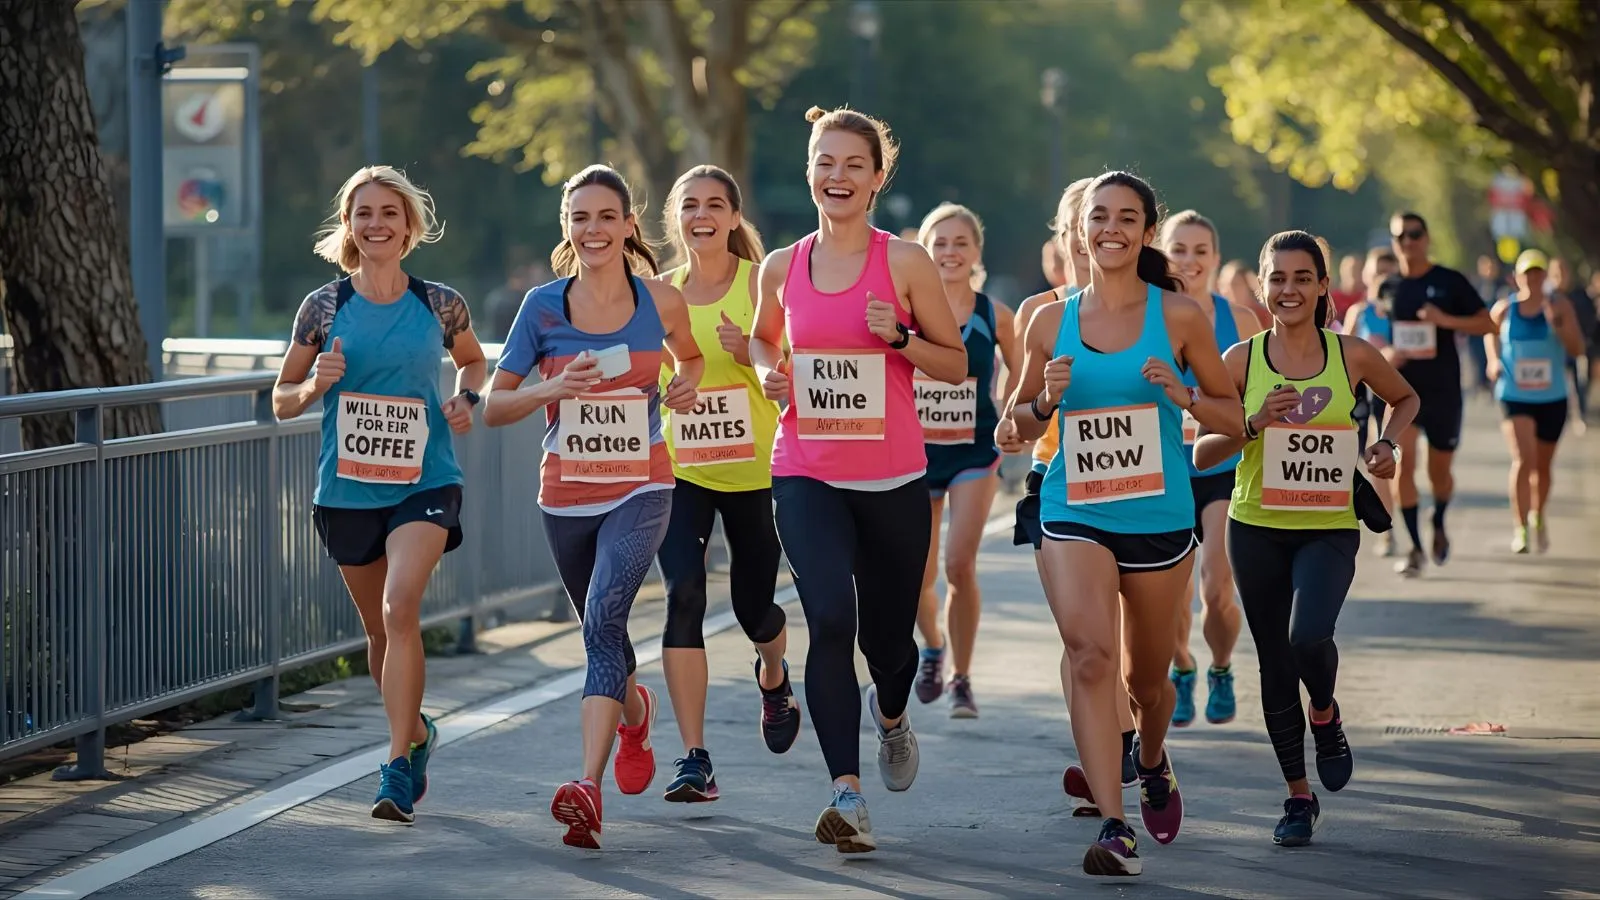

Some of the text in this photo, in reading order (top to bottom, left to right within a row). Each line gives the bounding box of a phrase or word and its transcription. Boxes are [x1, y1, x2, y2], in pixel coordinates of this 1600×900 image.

[814, 359, 858, 380] RUN
[809, 388, 867, 409] Wine
[346, 401, 418, 420] WILL RUN
[581, 404, 625, 424] RUN
[357, 418, 408, 434] FOR EIR
[681, 420, 745, 440] MATES
[1078, 416, 1132, 441] RUN
[345, 434, 415, 459] COFFEE
[1288, 433, 1334, 454] SOR
[1077, 445, 1143, 473] NOW
[1282, 461, 1342, 483] Wine
